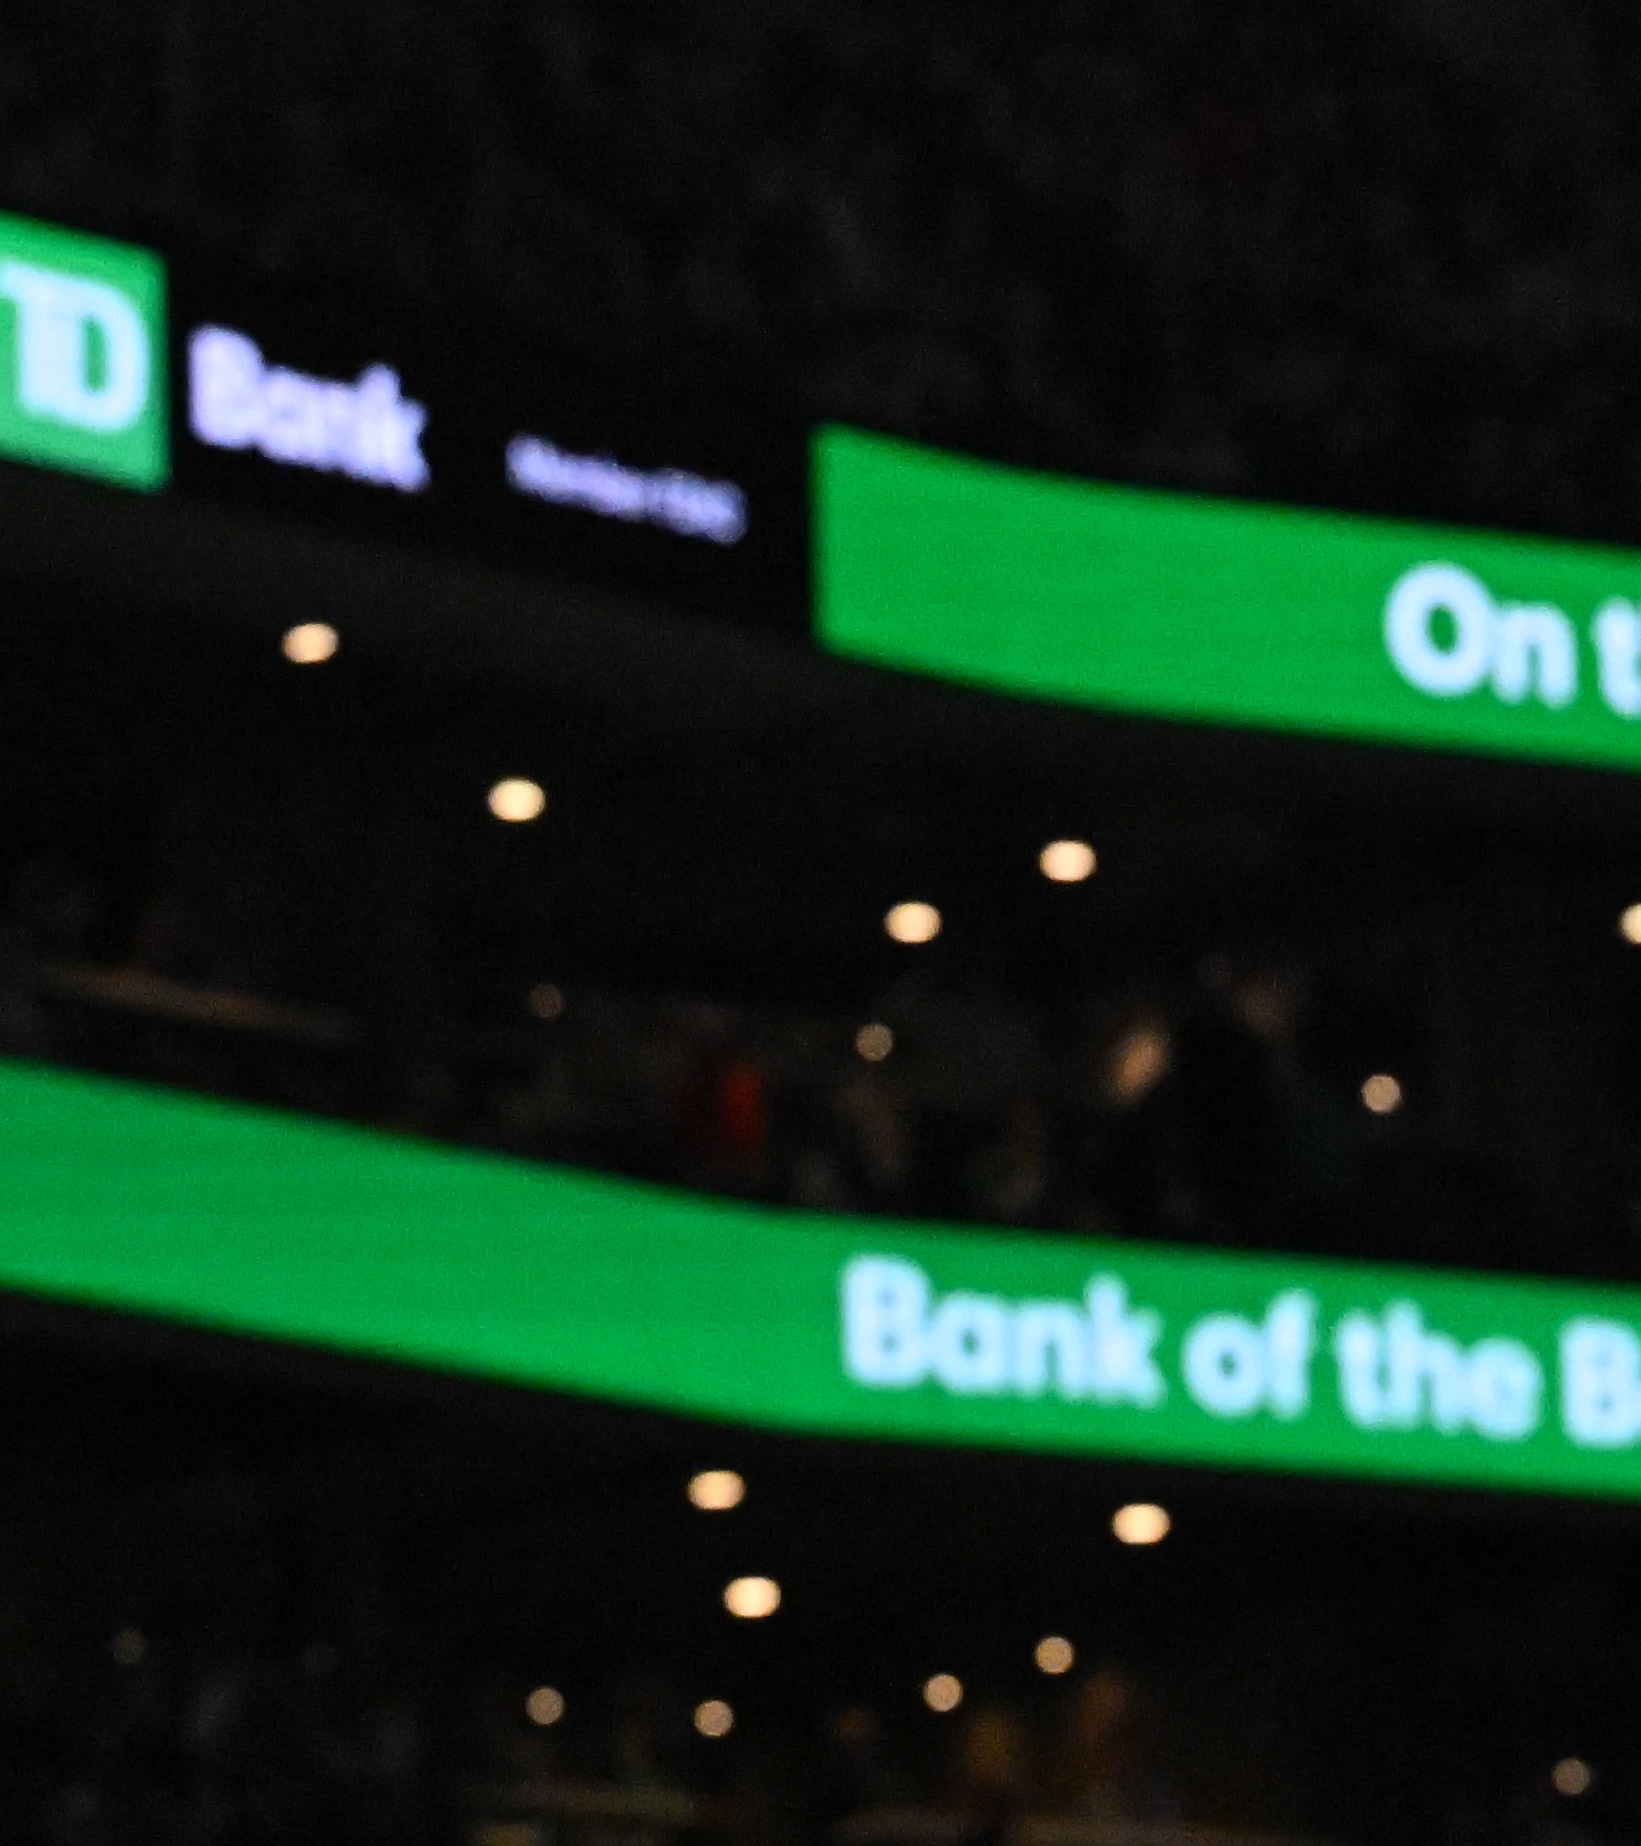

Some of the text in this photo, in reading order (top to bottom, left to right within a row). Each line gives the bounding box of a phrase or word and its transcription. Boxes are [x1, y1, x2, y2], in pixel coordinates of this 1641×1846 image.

[0, 256, 151, 438] TD
[1384, 561, 1579, 709] On
[838, 1254, 1167, 1409] Bank
[1181, 1288, 1320, 1421] of
[1334, 1299, 1545, 1443] the
